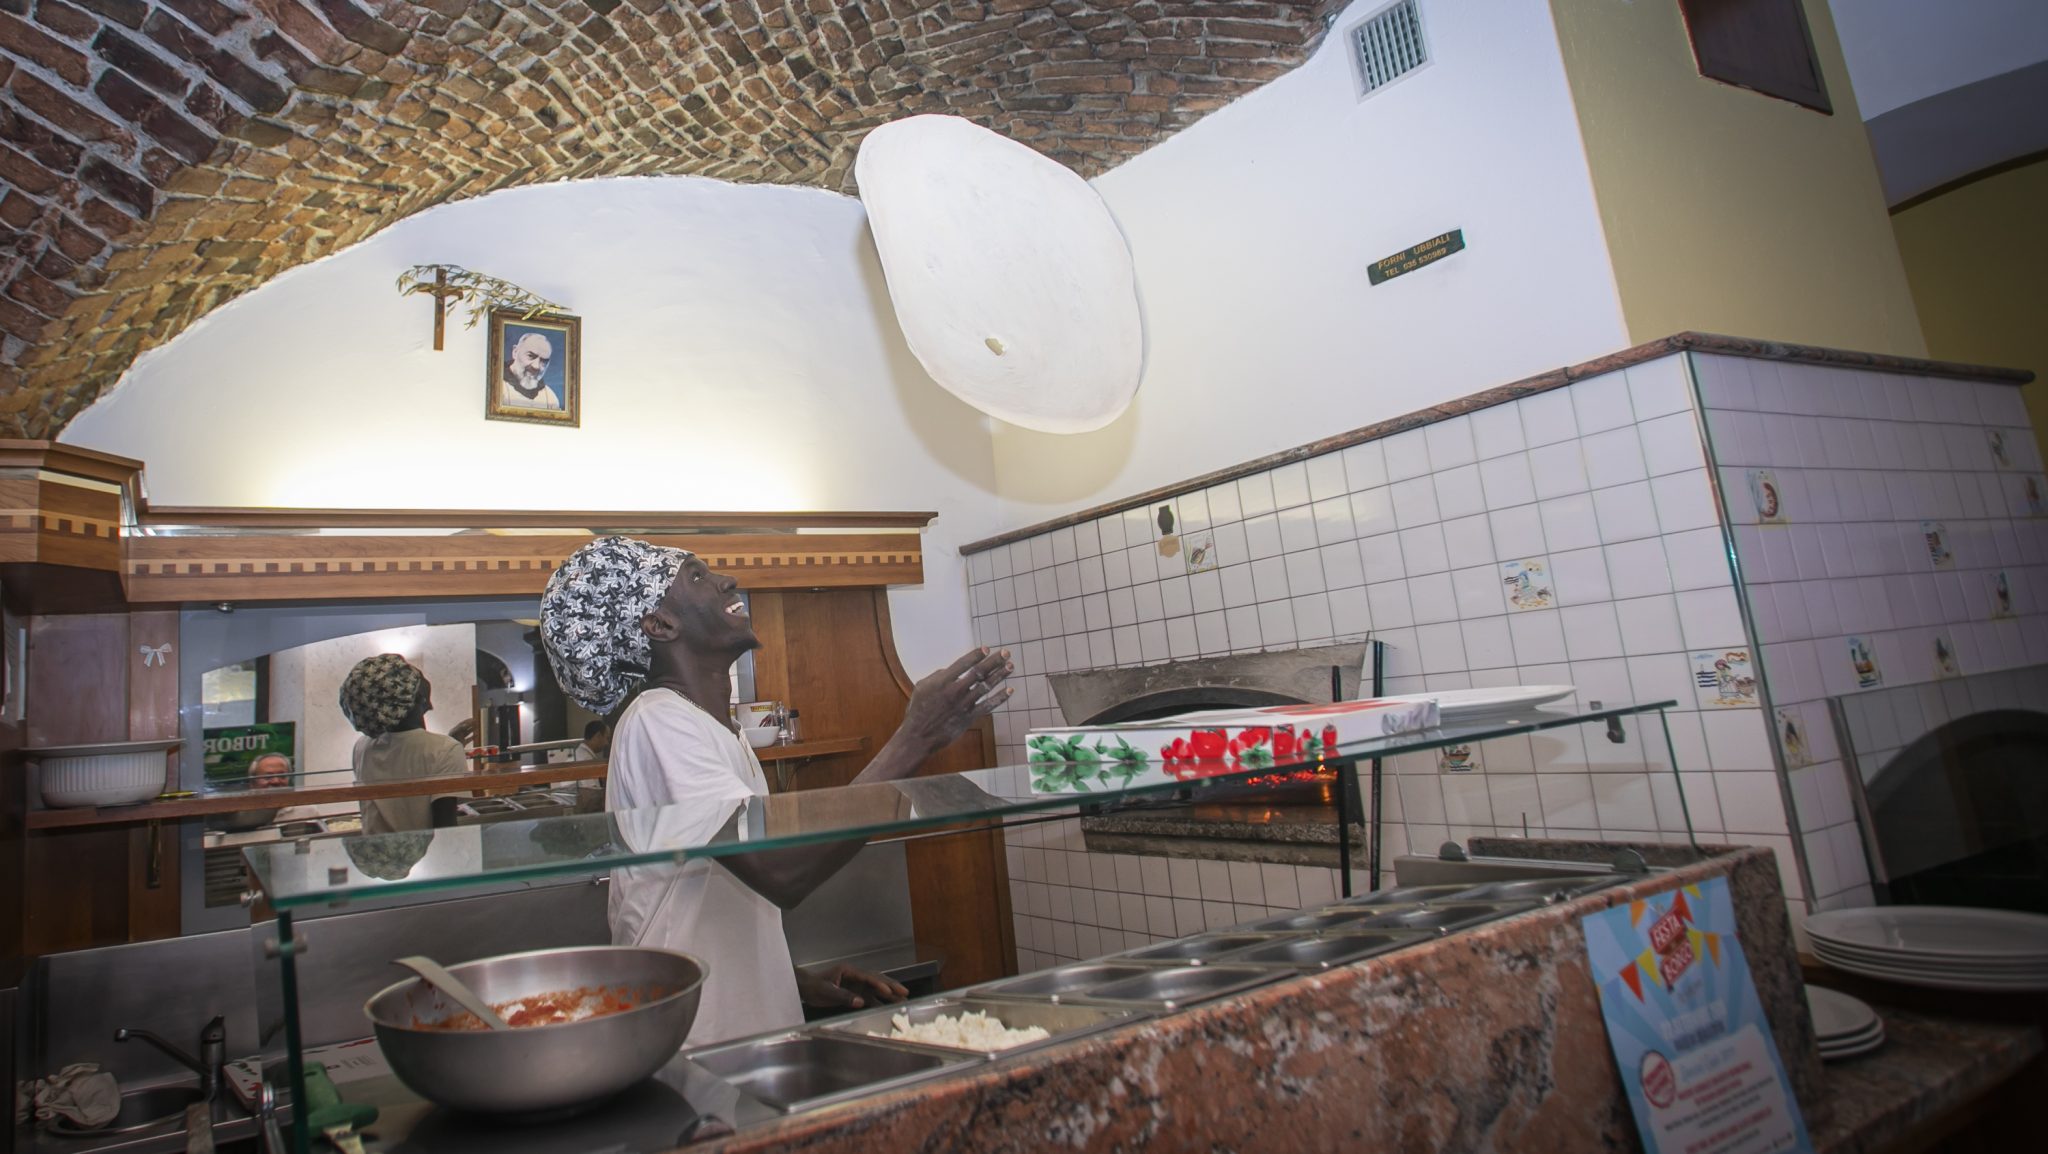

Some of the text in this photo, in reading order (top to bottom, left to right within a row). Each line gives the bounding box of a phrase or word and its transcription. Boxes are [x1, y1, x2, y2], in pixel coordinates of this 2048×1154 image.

[1378, 234, 1449, 270] FORNI UBBIALI
[1384, 267, 1400, 277] TEL
[1653, 914, 1682, 948] FESTA
